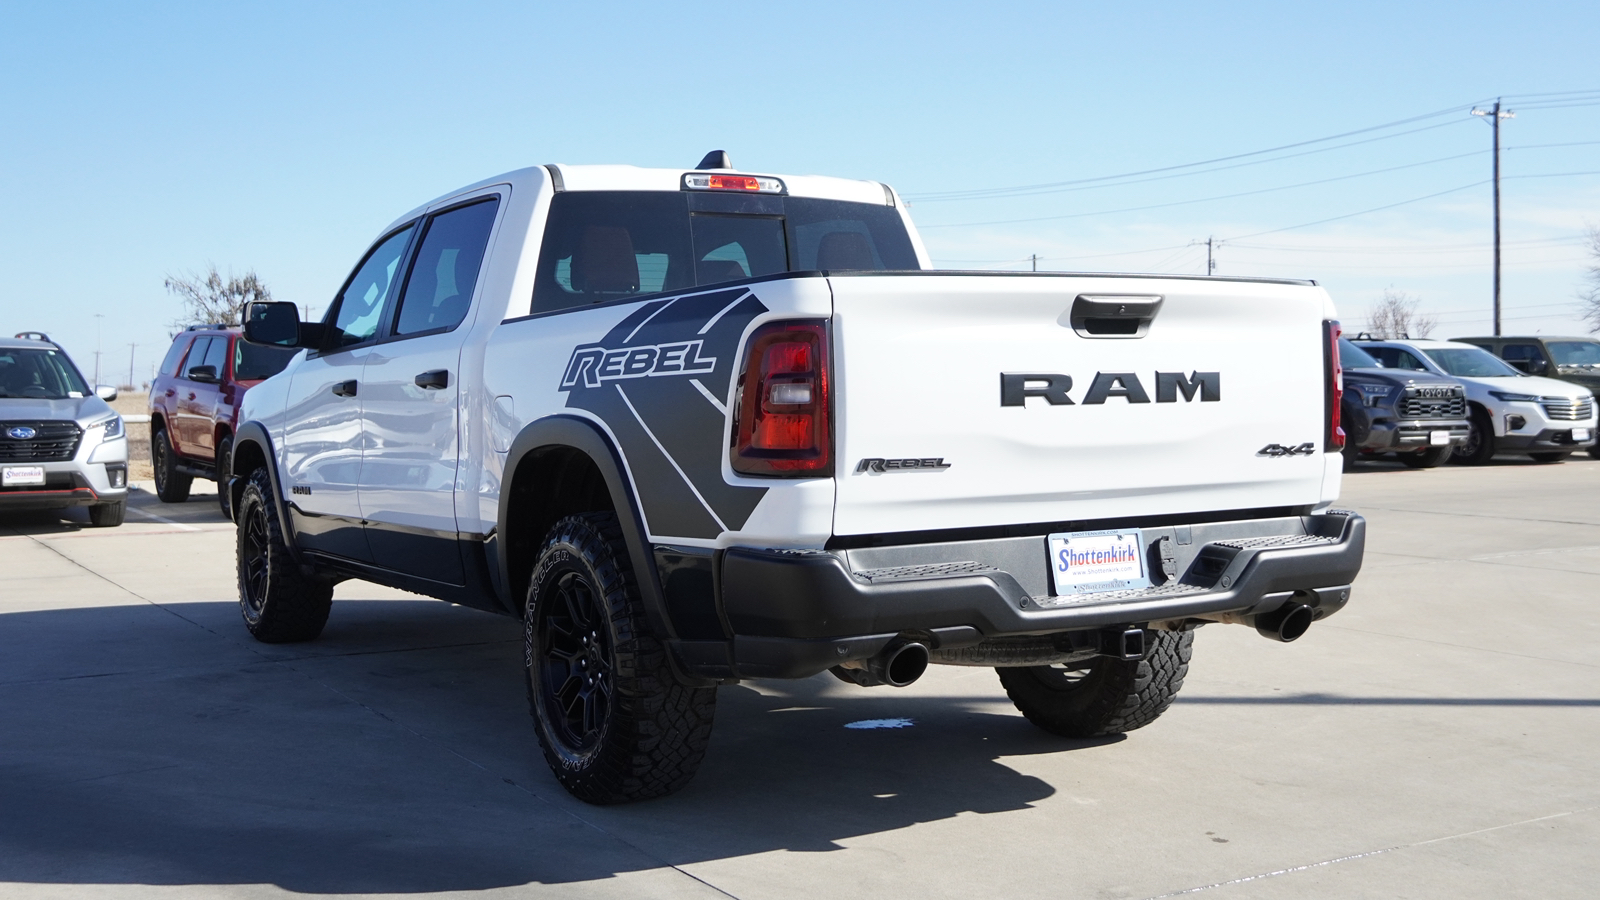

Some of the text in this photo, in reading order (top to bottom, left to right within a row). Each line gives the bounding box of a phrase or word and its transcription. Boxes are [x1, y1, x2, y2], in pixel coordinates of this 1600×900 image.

[561, 339, 717, 389] REBEL
[1000, 369, 1221, 408] RAM
[1418, 388, 1453, 398] TOYOTA
[1257, 442, 1316, 456] 4x4
[856, 457, 952, 473] REBEL
[292, 486, 312, 495] RAM
[1059, 544, 1135, 572] Shottenkirk
[525, 549, 571, 668] WRANGLER
